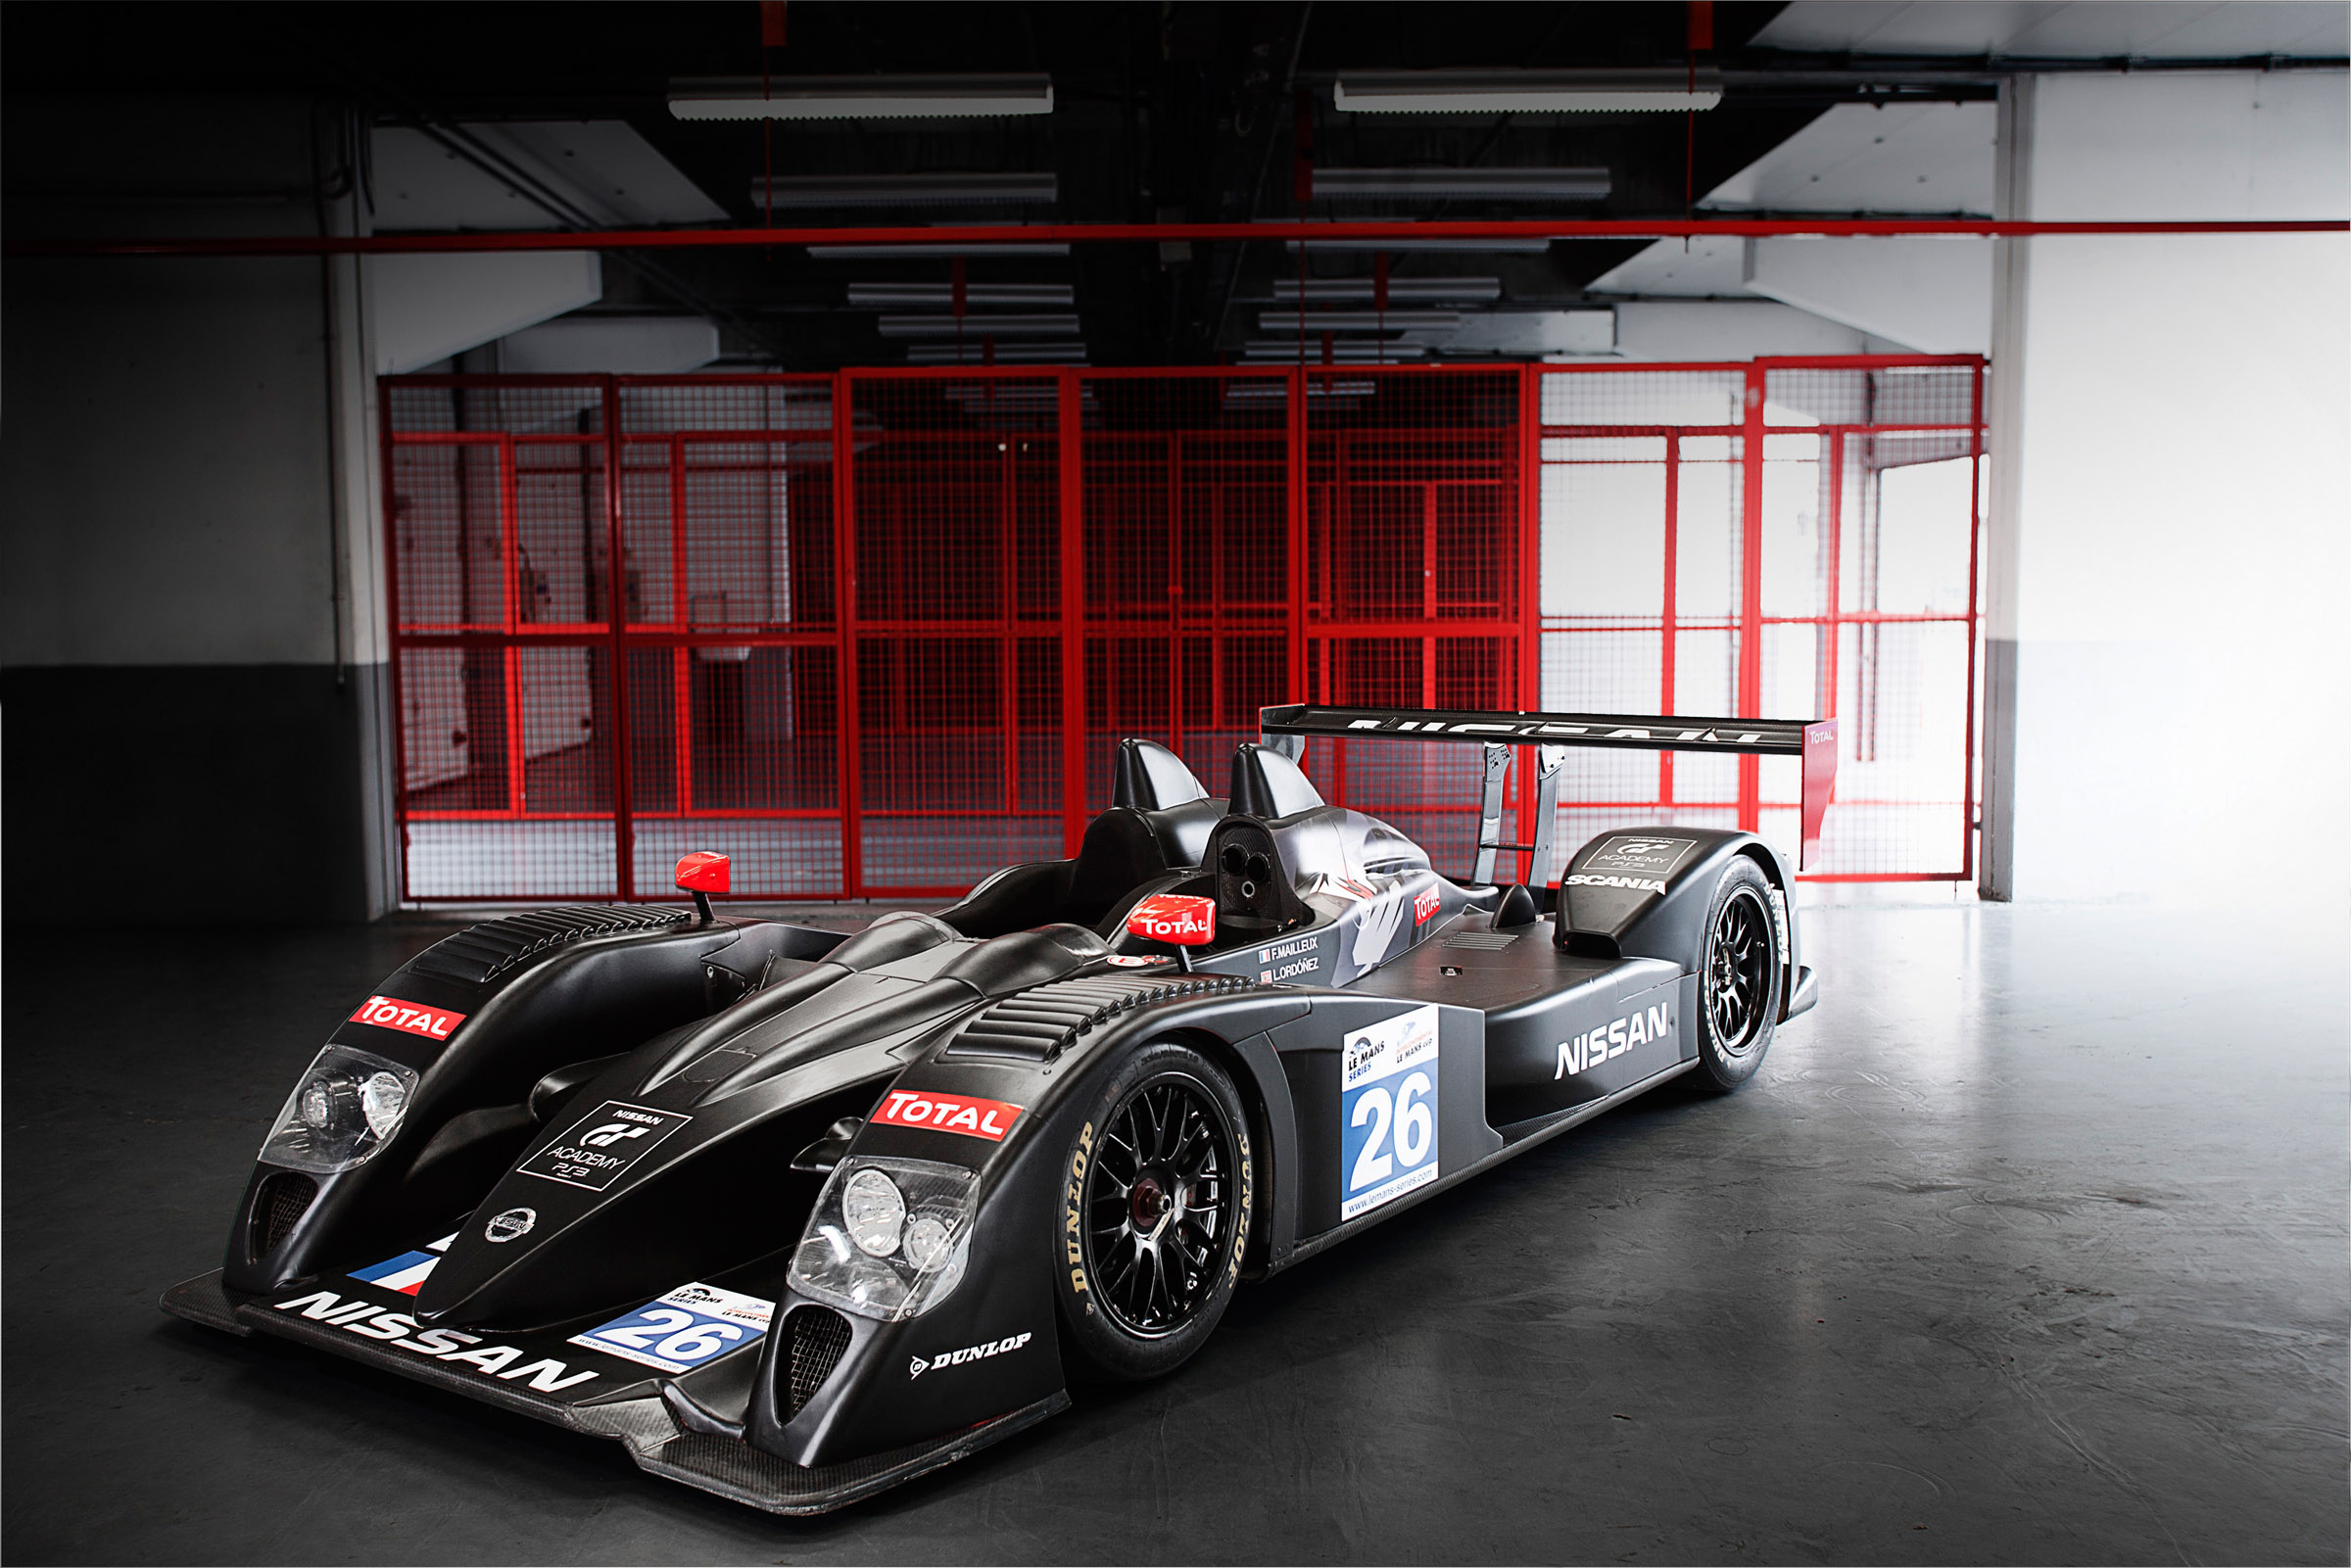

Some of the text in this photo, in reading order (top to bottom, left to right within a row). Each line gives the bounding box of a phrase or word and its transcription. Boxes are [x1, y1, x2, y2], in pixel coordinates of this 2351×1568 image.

[1809, 731, 1834, 744] TOTAL
[1564, 875, 1666, 895] SCANIA
[1140, 919, 1208, 934] TOTAL
[1271, 936, 1319, 961] F.MAILLEUX
[1273, 957, 1319, 981] L.ORDÓÑEZ
[362, 997, 448, 1036] TOTAL
[1405, 1042, 1421, 1059] MANS
[1554, 1001, 1668, 1080] NISSAN
[1348, 1040, 1385, 1071] LE MANS
[1348, 1062, 1371, 1082] SERIES
[612, 1110, 664, 1125] NISSAN
[887, 1092, 1004, 1135] TOTAL
[1350, 1071, 1433, 1192] 26
[547, 1146, 626, 1169] ACADEMY
[552, 1162, 591, 1177] PS3
[1348, 1168, 1433, 1213] www.lemans-series.com
[1066, 1121, 1093, 1294] DUNLOP
[688, 1294, 723, 1304] MANS
[274, 1291, 600, 1393] NISSAN
[594, 1308, 744, 1360] 26
[931, 1332, 1032, 1370] DUNLOP
